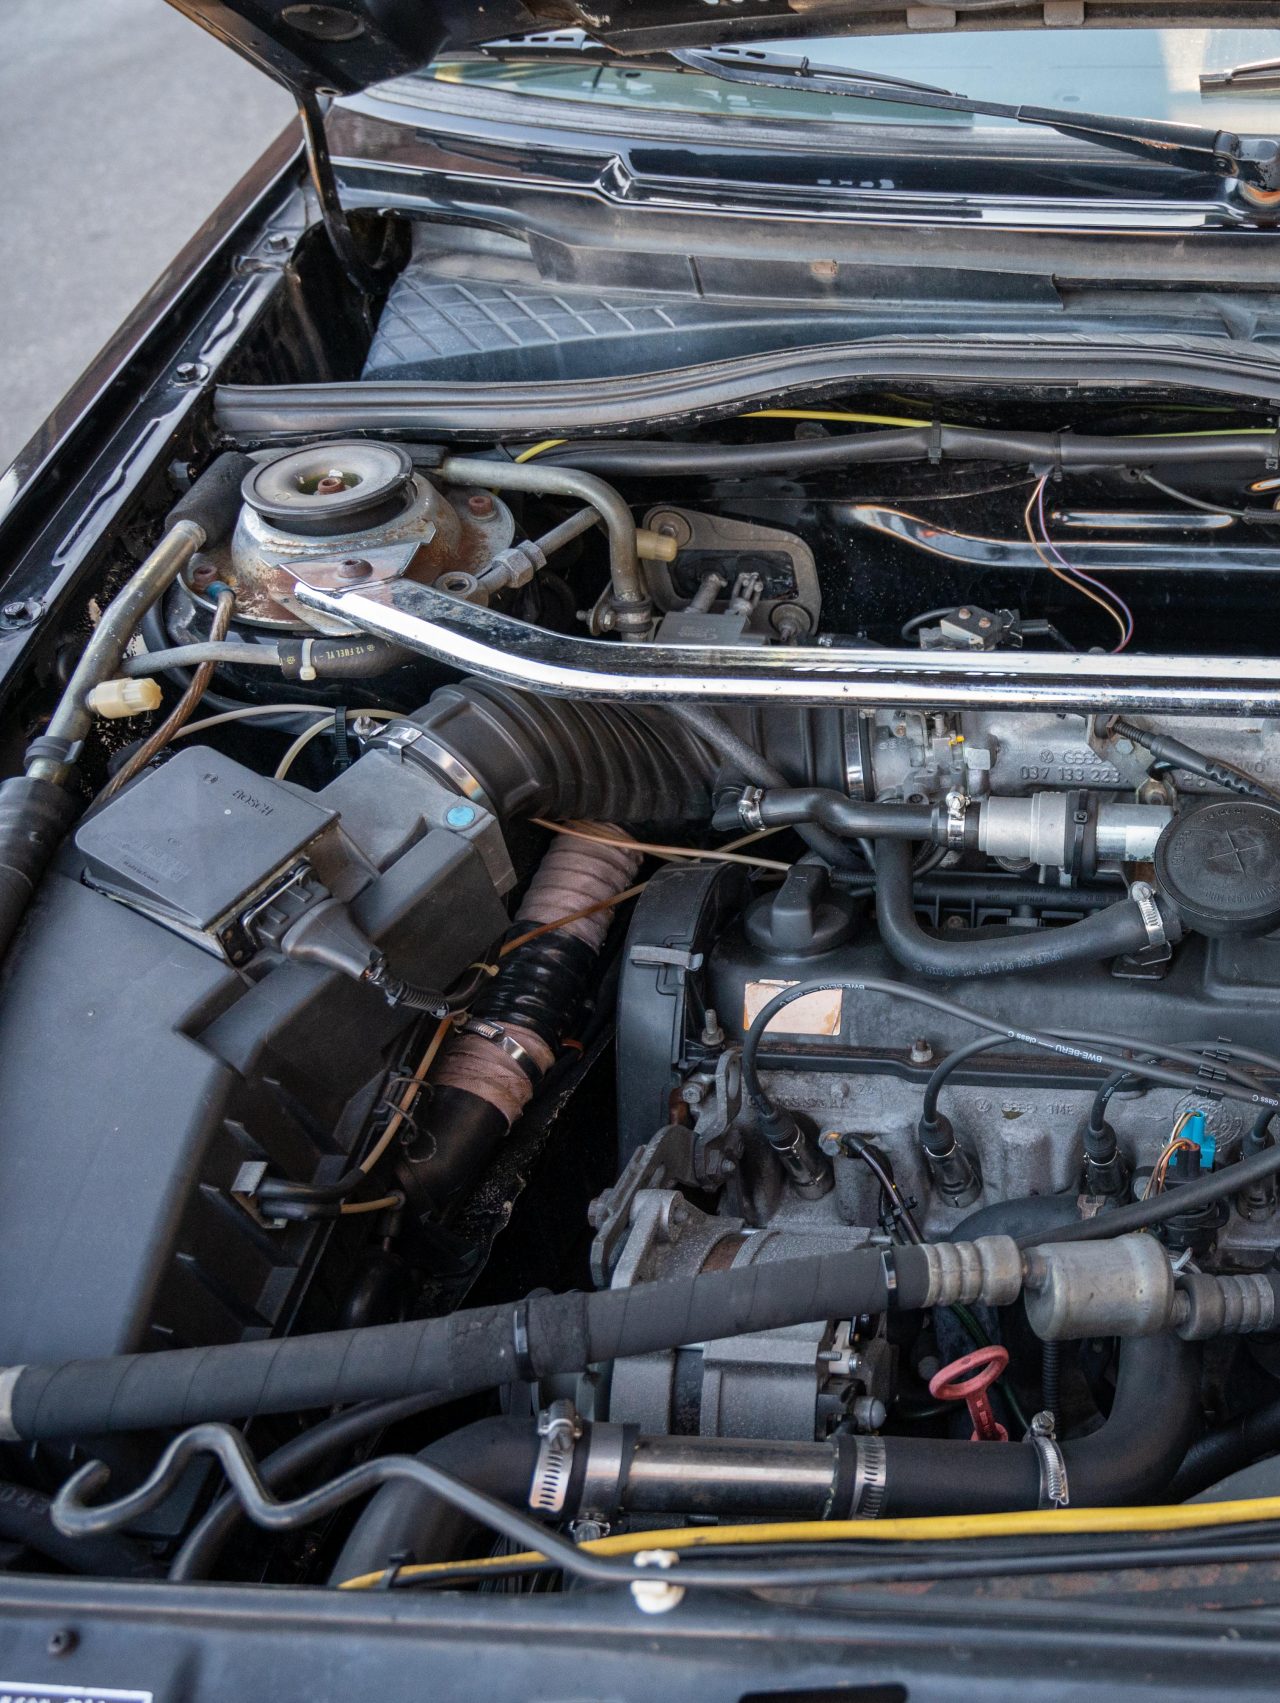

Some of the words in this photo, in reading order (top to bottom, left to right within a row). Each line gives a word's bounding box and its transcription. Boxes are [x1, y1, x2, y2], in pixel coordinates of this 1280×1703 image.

[336, 648, 354, 658] FUEL
[1019, 766, 1049, 782] 037
[1058, 766, 1085, 783] 133
[1007, 1030, 1015, 1039] C
[1016, 1031, 1037, 1045] class
[1054, 1042, 1103, 1063] BWE-BERU
[1252, 1094, 1259, 1102] C
[1260, 1096, 1278, 1107] class
